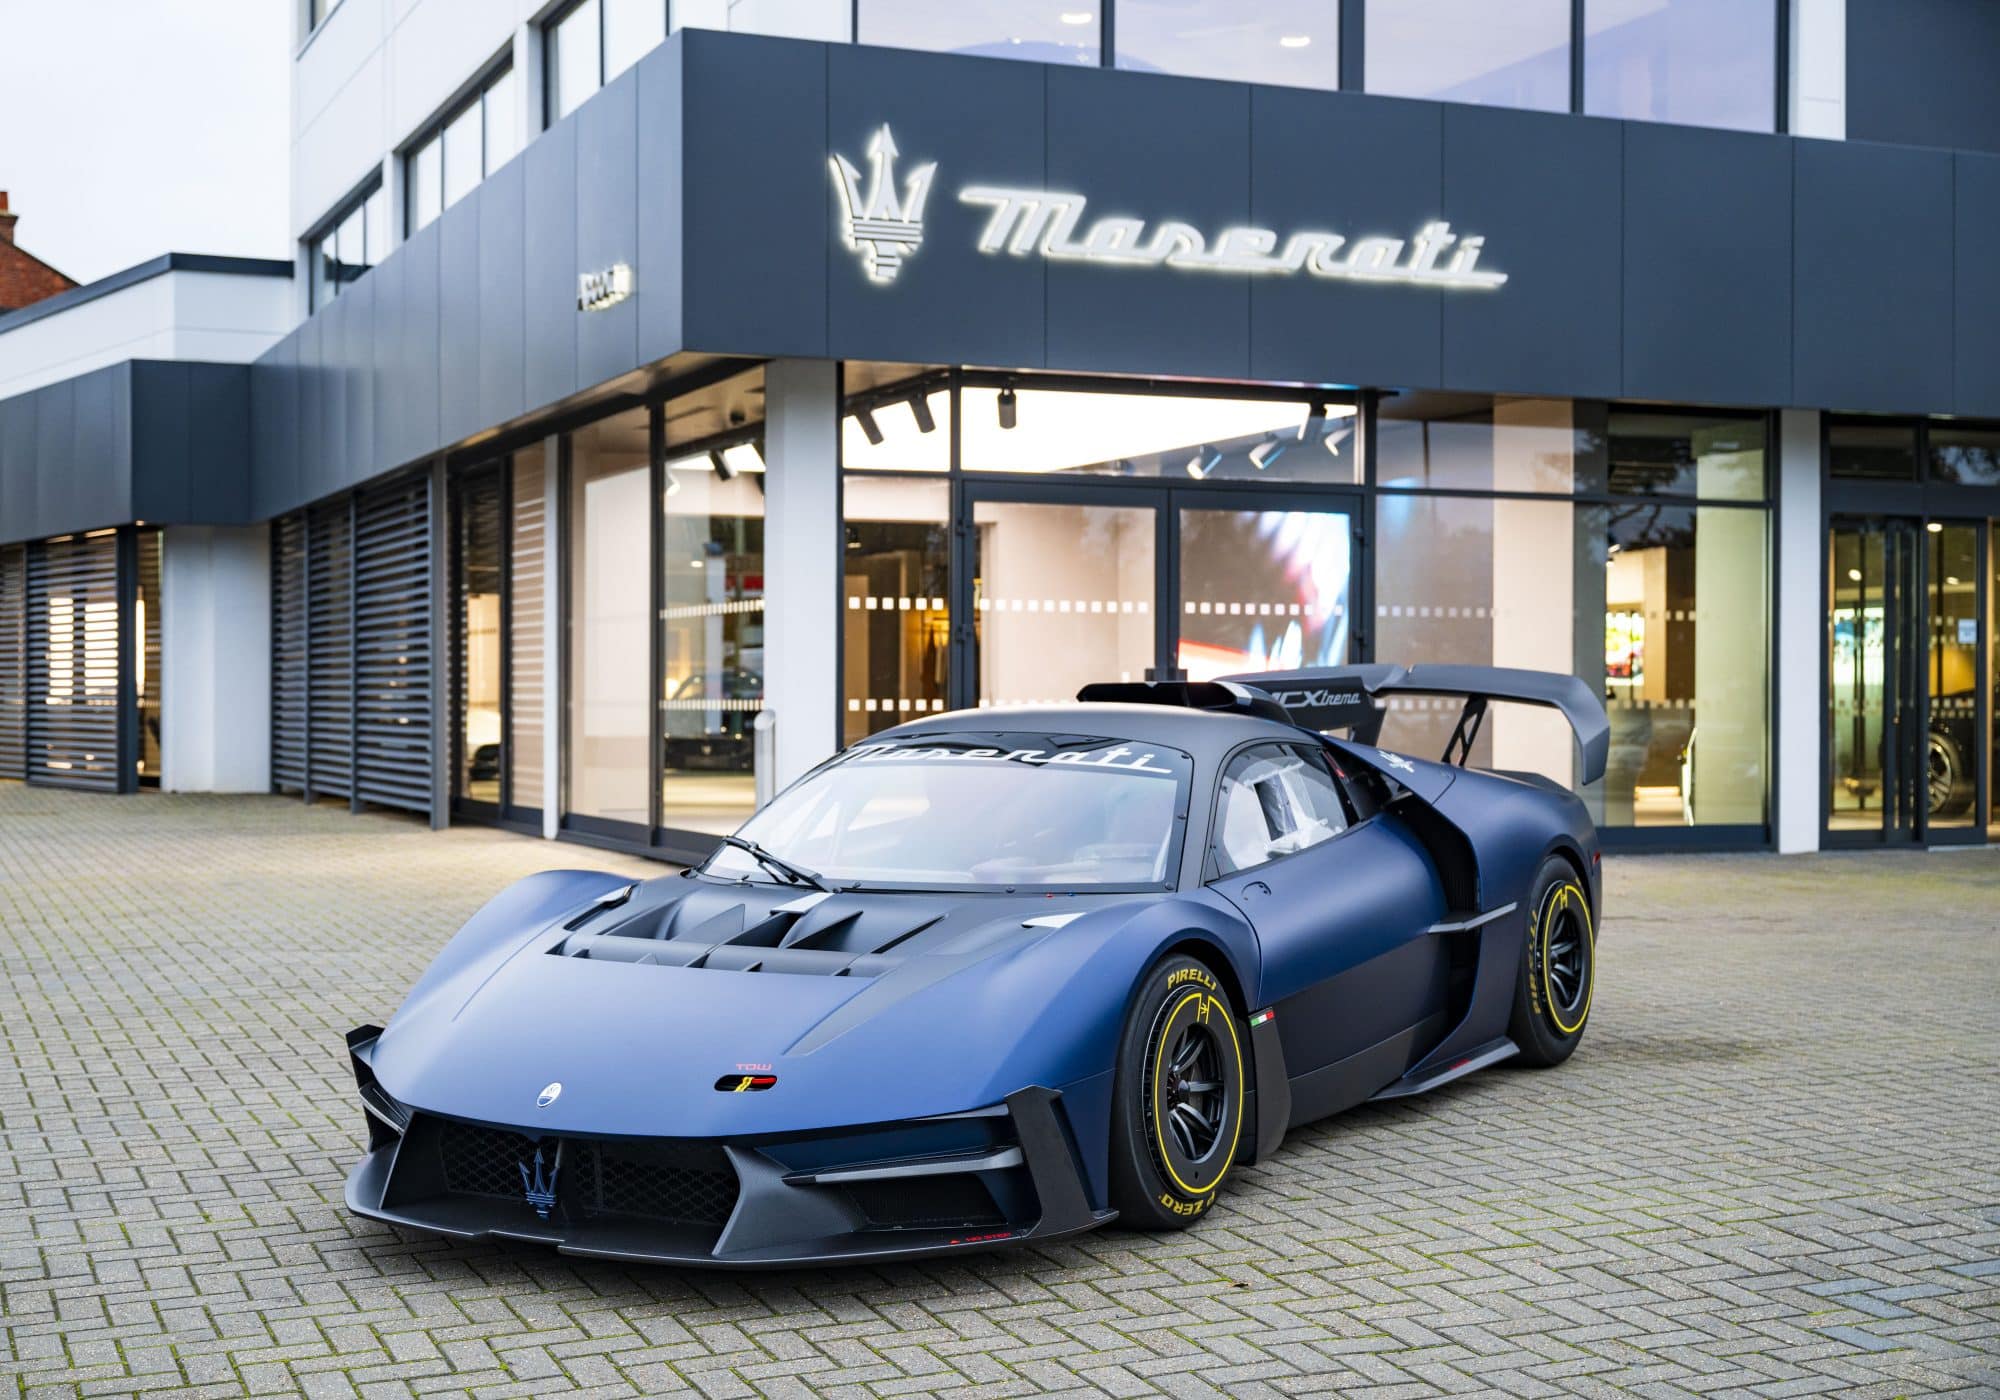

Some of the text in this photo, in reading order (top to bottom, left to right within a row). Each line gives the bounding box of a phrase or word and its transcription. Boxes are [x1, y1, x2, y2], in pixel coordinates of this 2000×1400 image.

[957, 186, 1509, 289] Maserati
[845, 744, 1172, 773] Maserati
[1167, 968, 1217, 991] PIRELLI
[735, 1062, 773, 1072] TOW
[1161, 1193, 1204, 1216] ZERO
